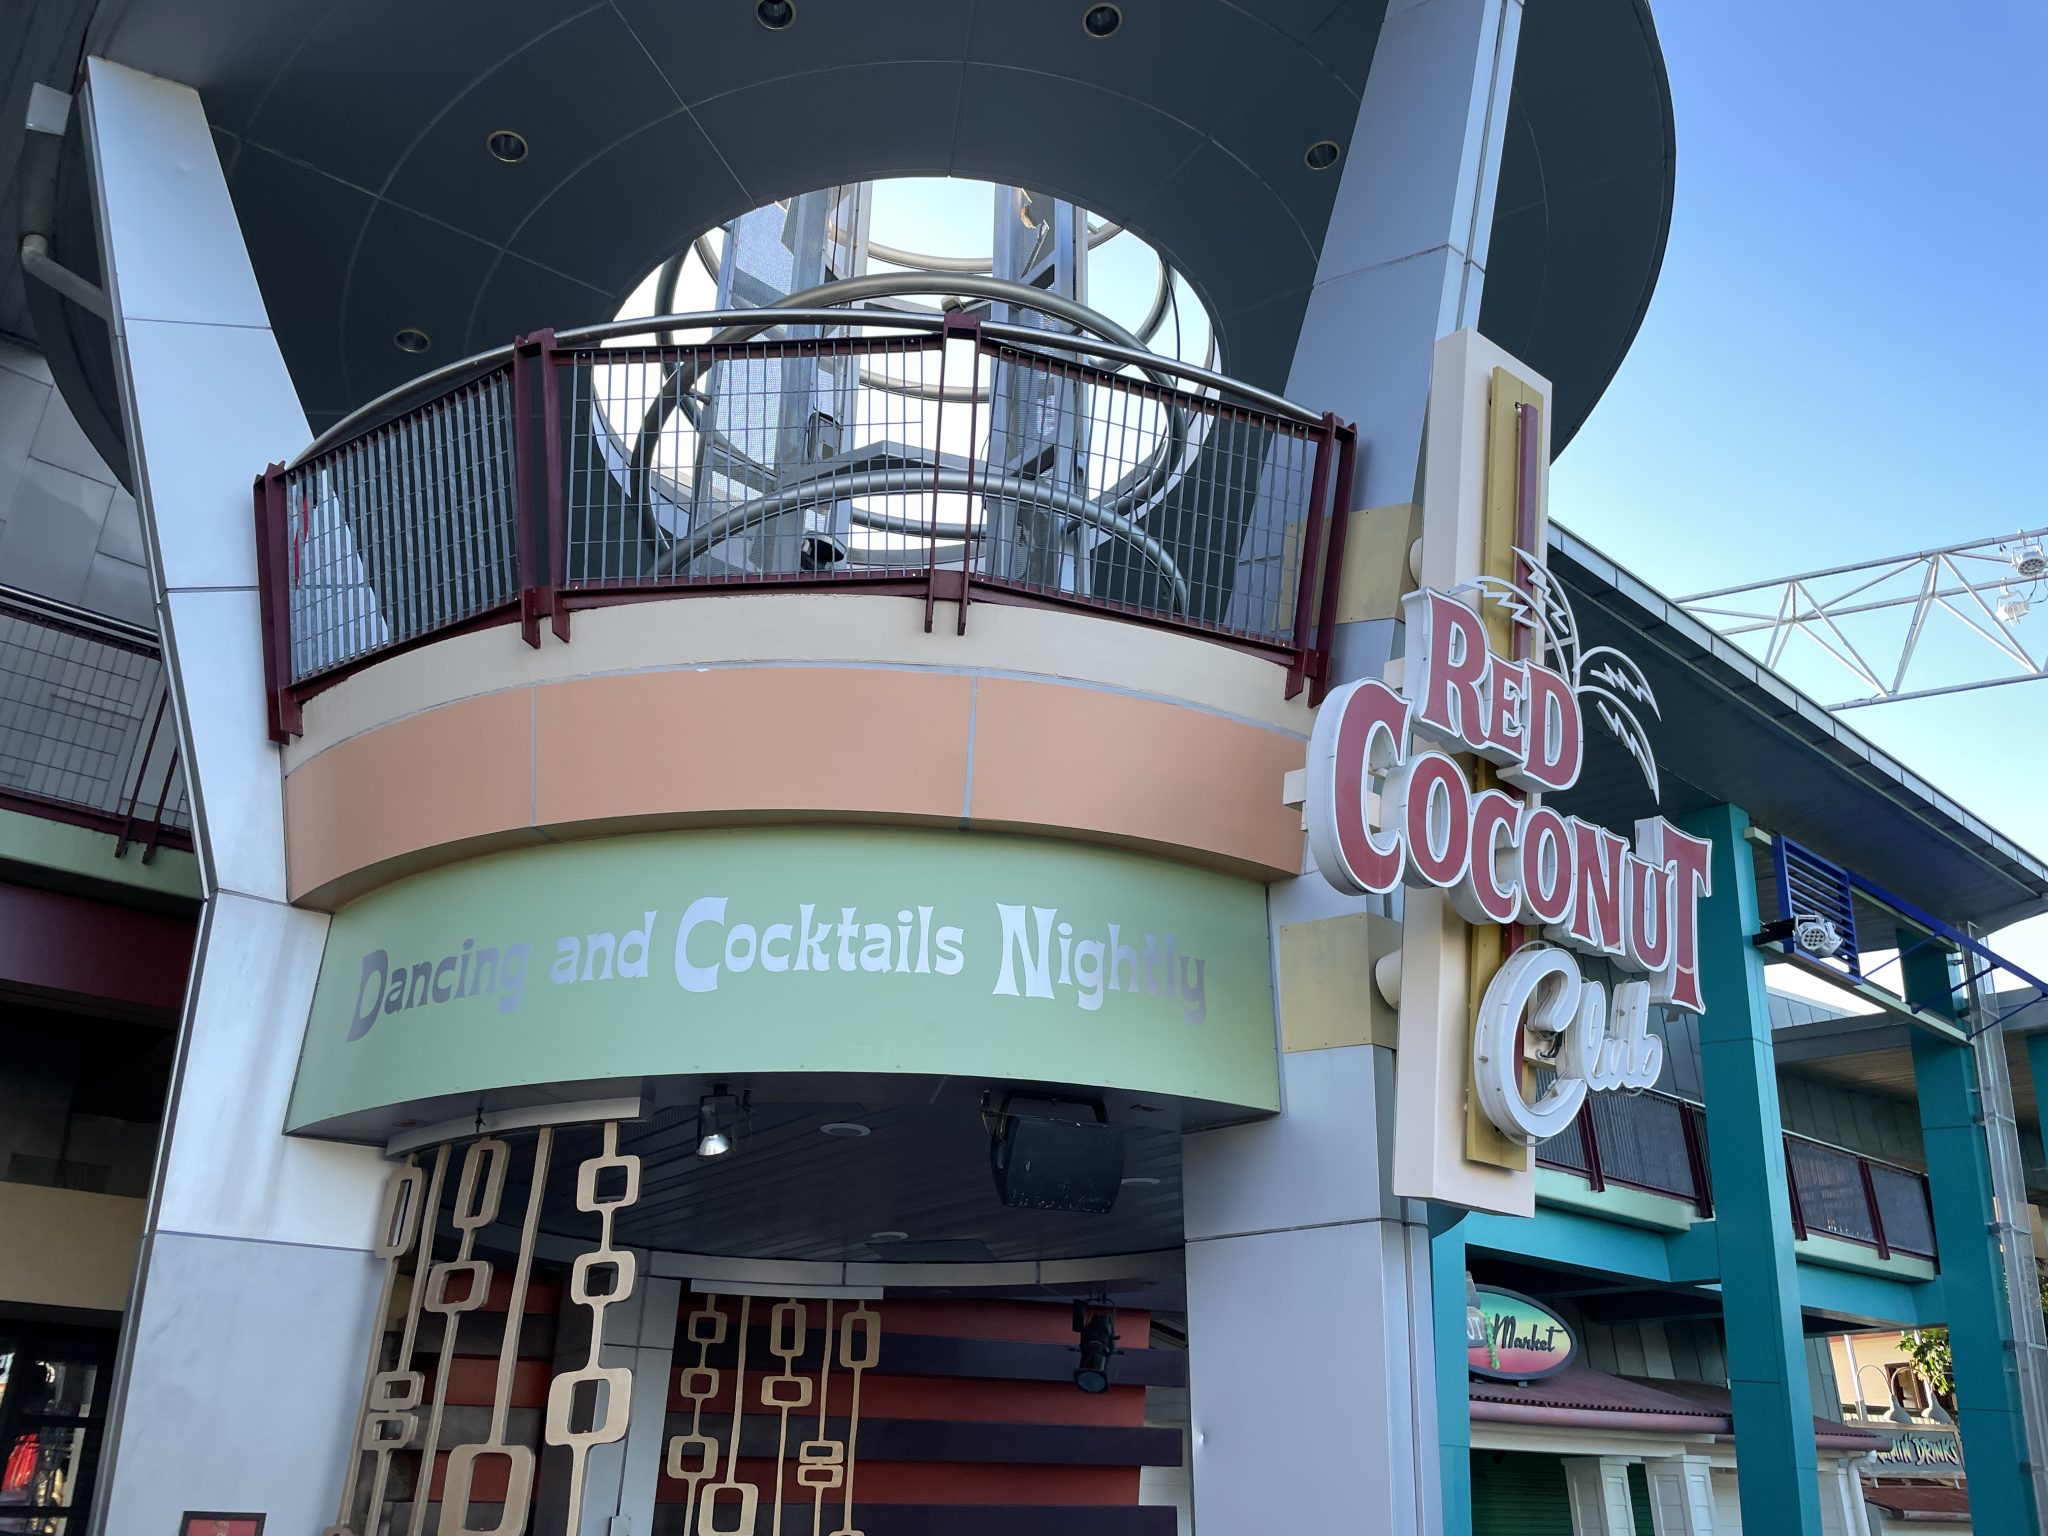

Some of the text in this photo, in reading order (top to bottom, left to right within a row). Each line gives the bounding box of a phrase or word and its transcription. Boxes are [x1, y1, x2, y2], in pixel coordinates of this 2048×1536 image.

[1405, 587, 1584, 793] RED
[1308, 676, 1713, 1016] COCONUT
[345, 896, 1207, 1044] Dancing and Cocktails Nightly
[1474, 940, 1663, 1140] Club
[1493, 1313, 1565, 1352] Market
[1912, 1437, 1960, 1466] DRINKS
